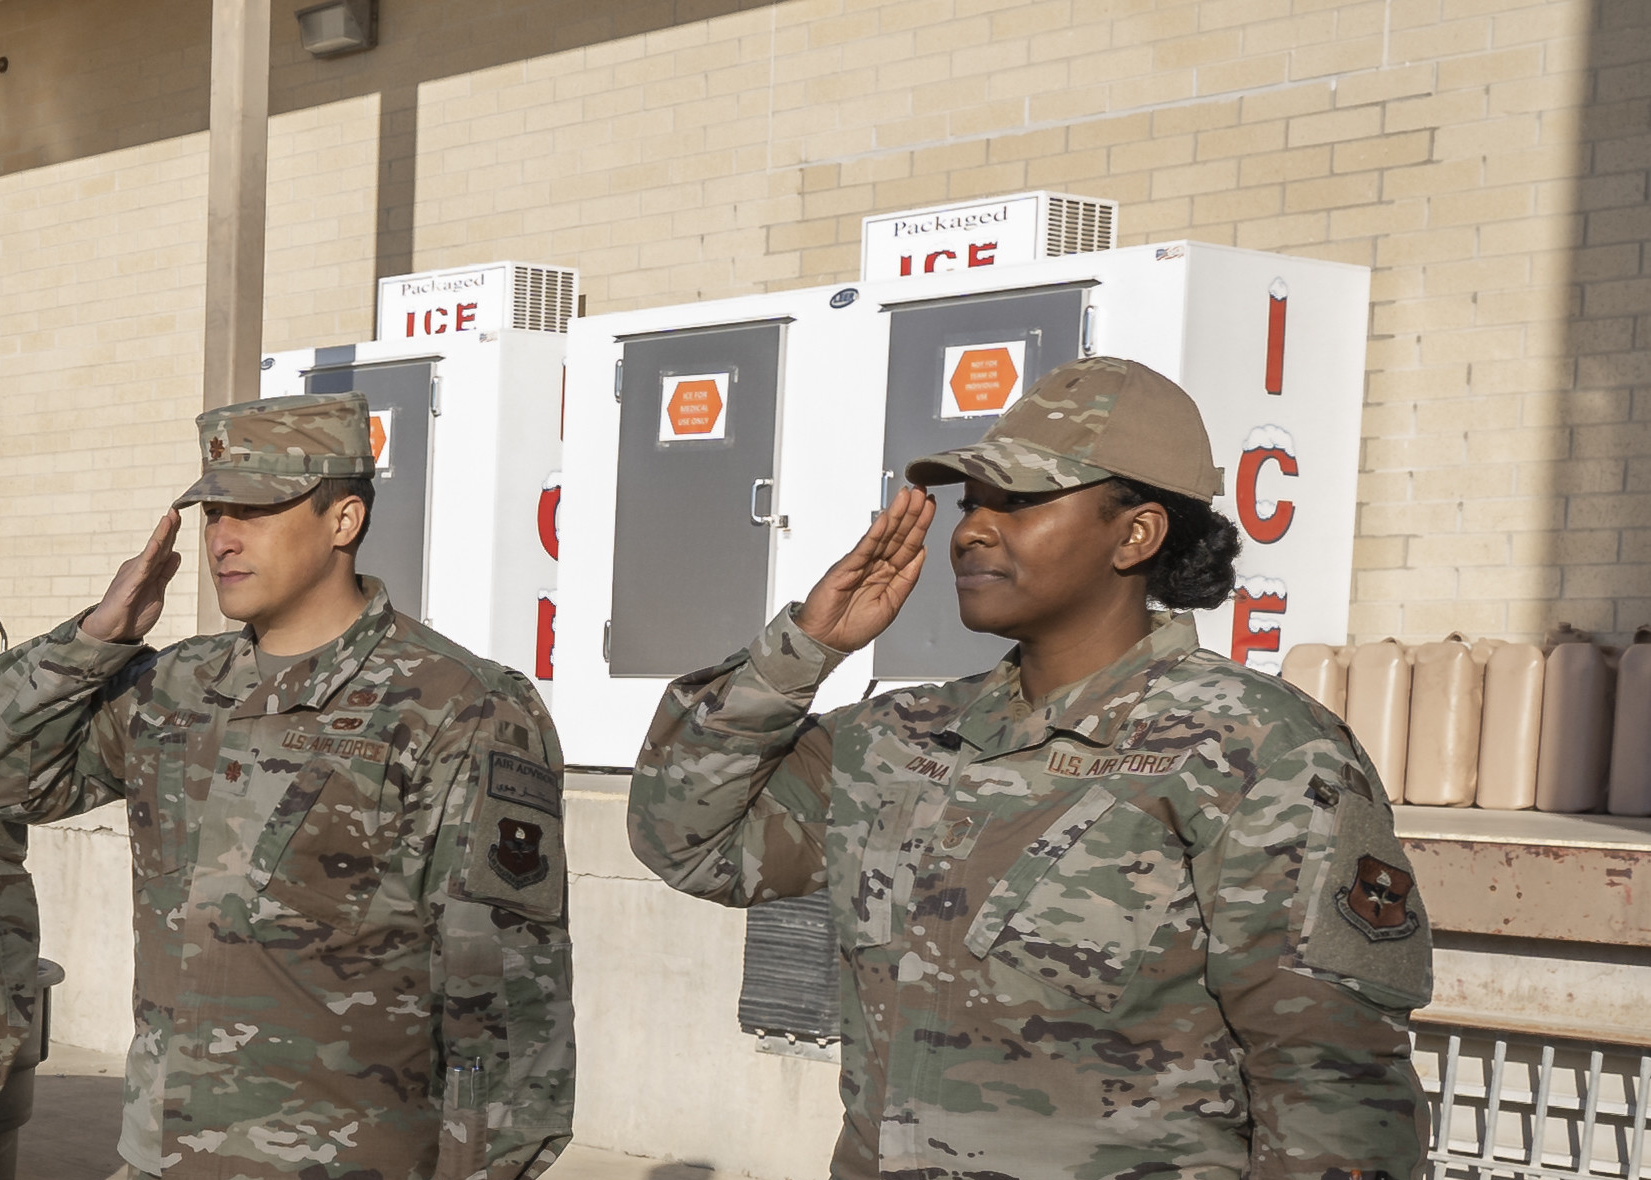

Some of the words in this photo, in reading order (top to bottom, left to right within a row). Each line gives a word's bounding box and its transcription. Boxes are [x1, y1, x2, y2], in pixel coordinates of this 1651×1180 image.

[892, 205, 1008, 237] Packaged
[900, 241, 998, 277] ICE
[402, 273, 485, 296] Packaged
[406, 302, 478, 338] ICE
[682, 391, 694, 400] ICE
[694, 391, 708, 400] FOR
[678, 418, 690, 426] USE
[691, 417, 709, 426] ONLY
[680, 404, 708, 414] MEDICAL
[309, 735, 334, 753] AIR
[334, 738, 385, 763] FORCE
[494, 757, 514, 770] AIR
[905, 755, 950, 781] CHINA
[1048, 751, 1083, 777] U.S.
[1085, 758, 1119, 776] AIR
[1116, 754, 1181, 773] FORCE
